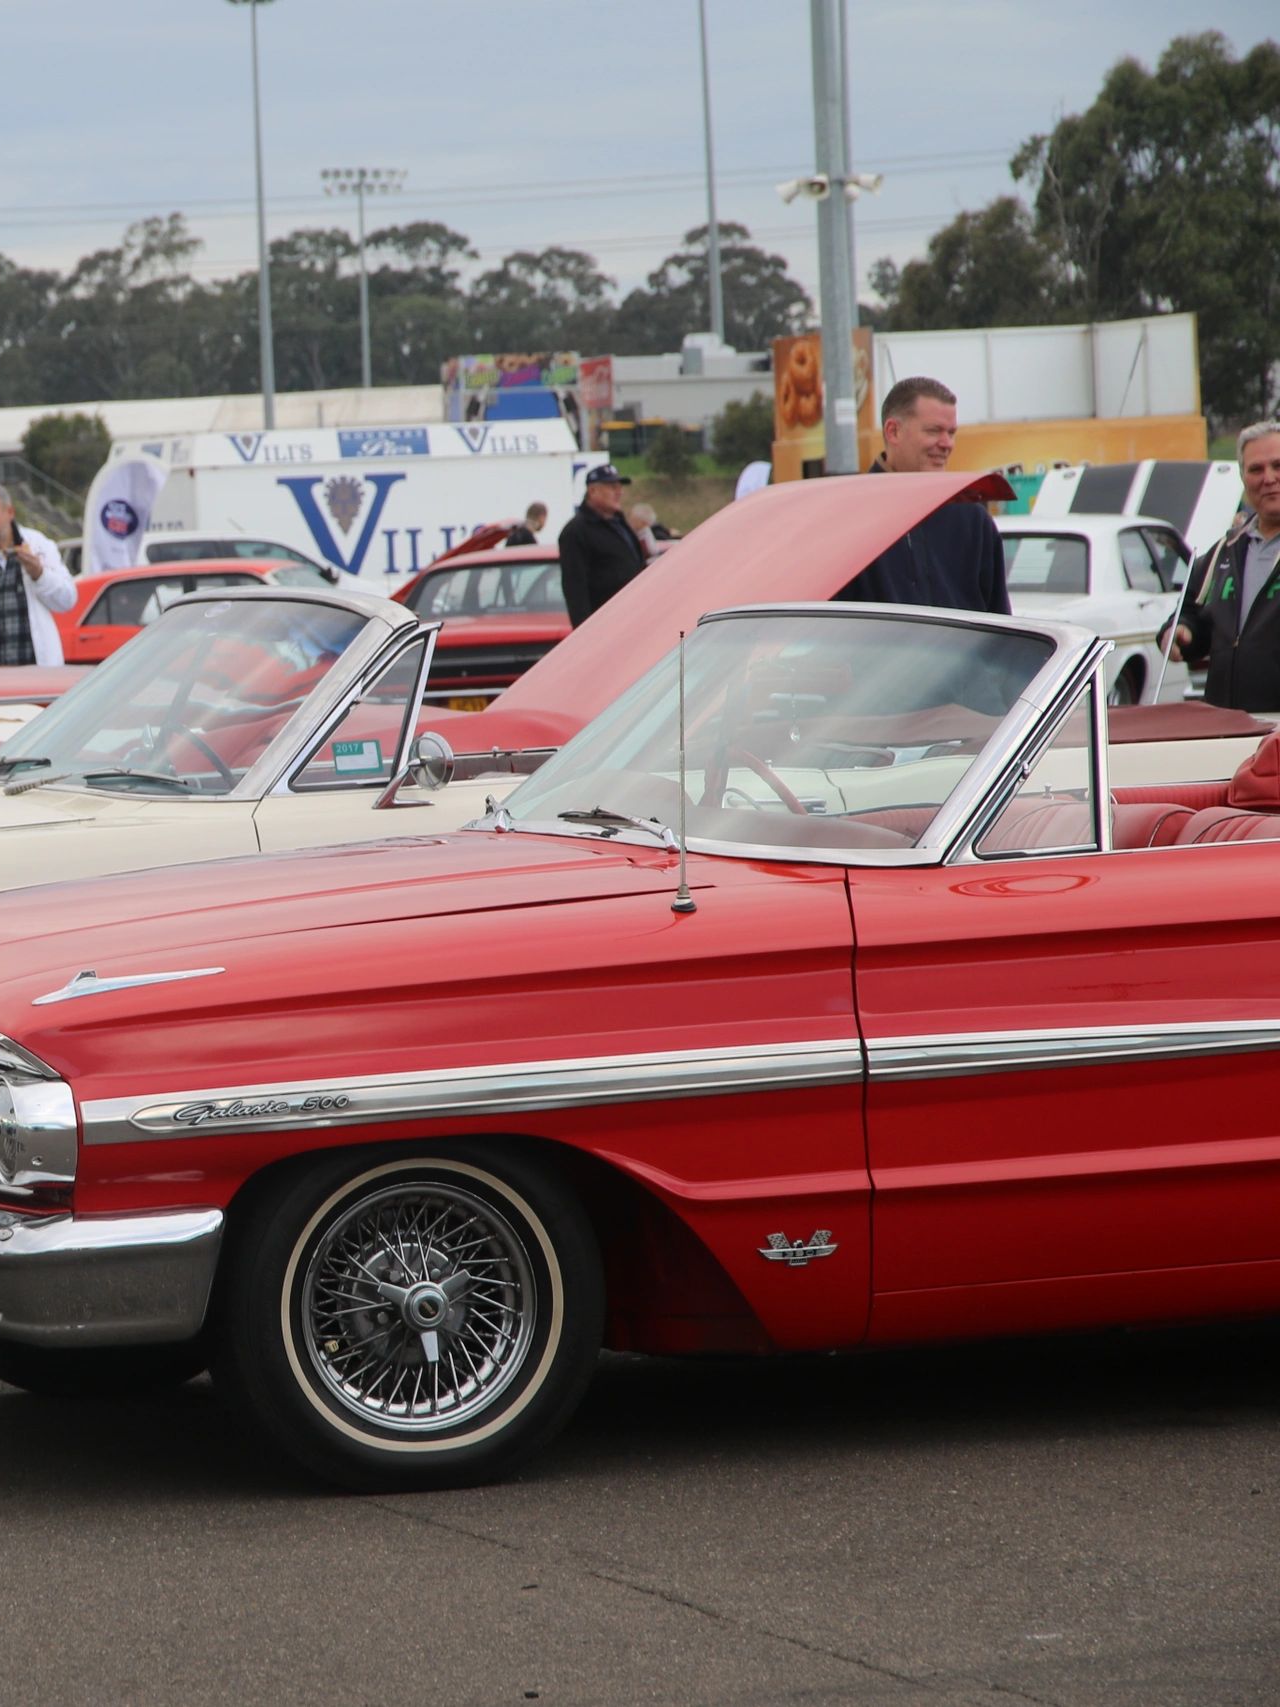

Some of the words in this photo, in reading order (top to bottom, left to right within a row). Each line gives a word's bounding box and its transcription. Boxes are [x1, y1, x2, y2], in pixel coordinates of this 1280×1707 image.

[335, 743, 359, 753] 2017
[173, 1100, 289, 1126] Galaxie
[298, 1094, 350, 1112] 500
